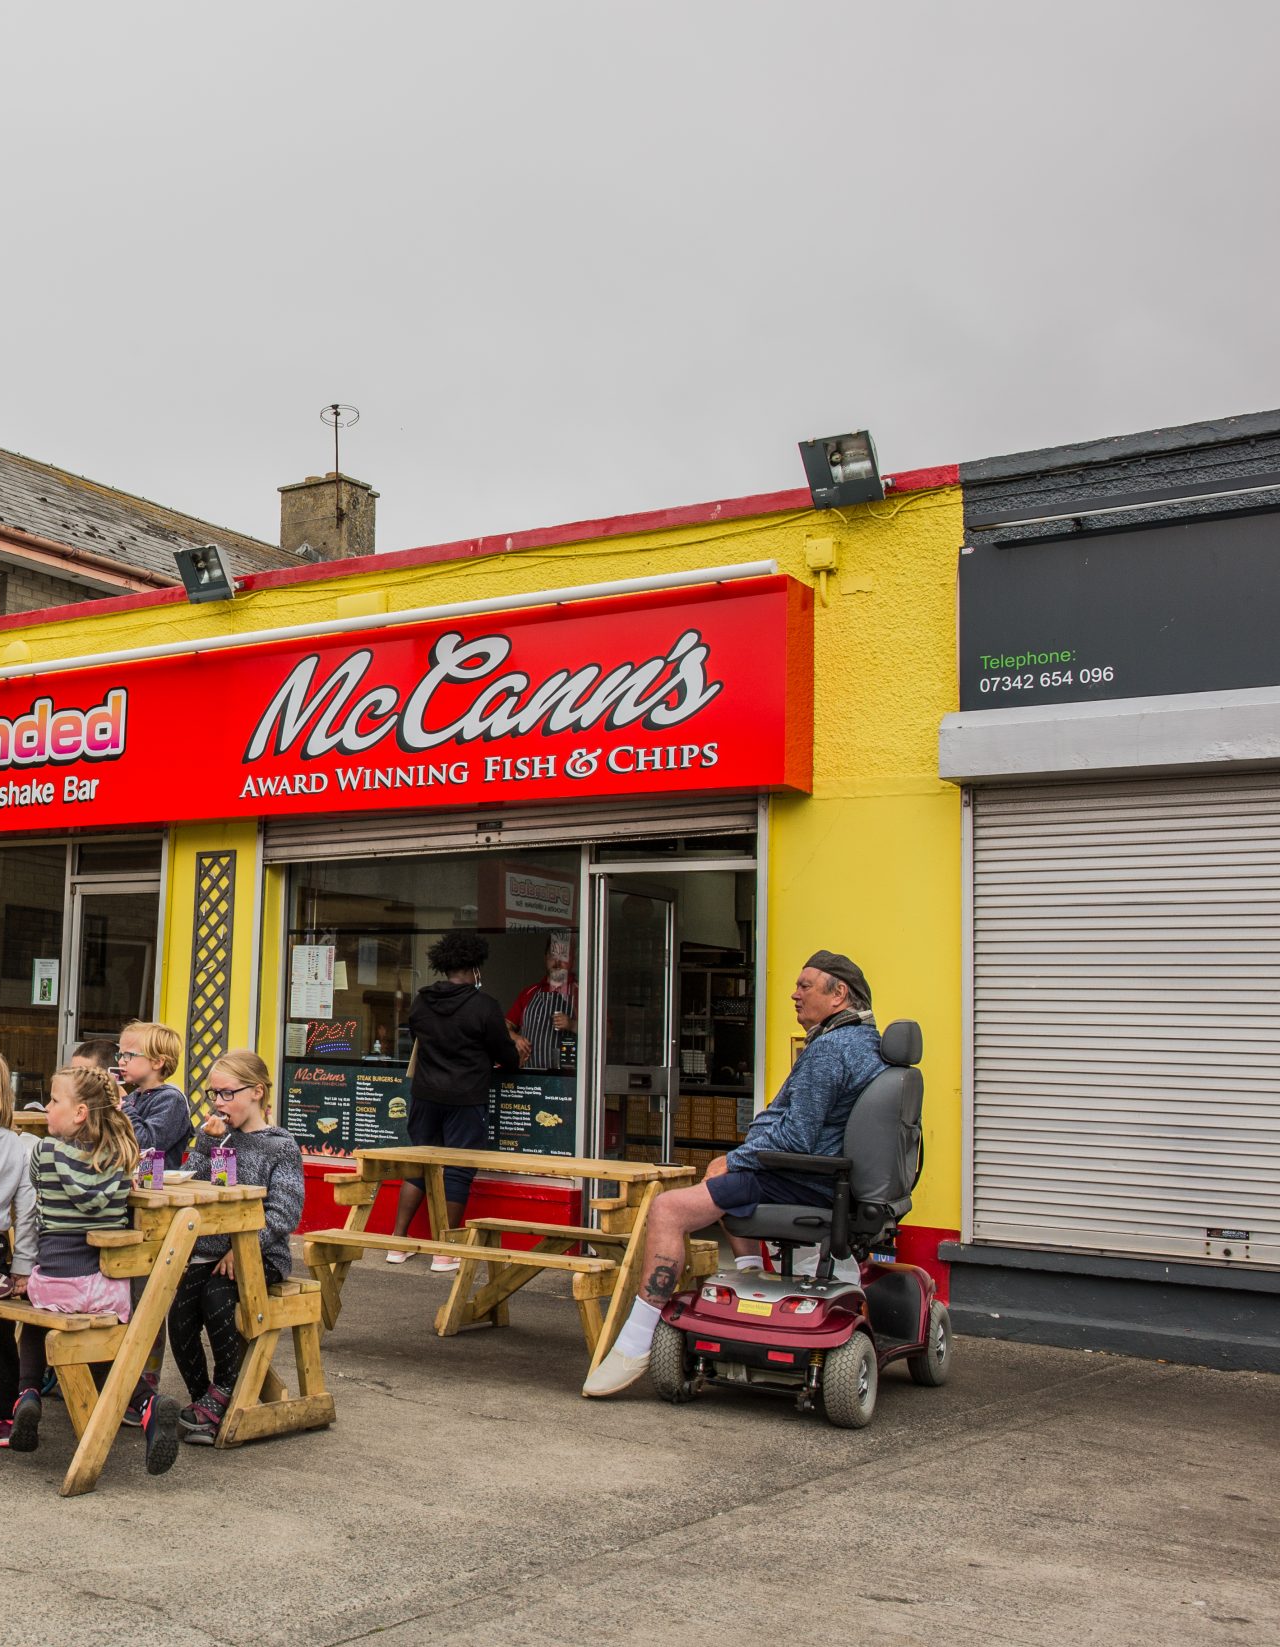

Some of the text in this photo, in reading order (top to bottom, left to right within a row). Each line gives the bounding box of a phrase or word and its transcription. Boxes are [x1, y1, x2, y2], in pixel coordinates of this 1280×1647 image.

[980, 650, 1076, 671] Telephone:
[979, 667, 1114, 693] 07342 654 096
[242, 628, 723, 764] McCann's
[239, 742, 719, 798] AWARD WINNING FISH & CHIPS
[64, 777, 99, 803] Bar
